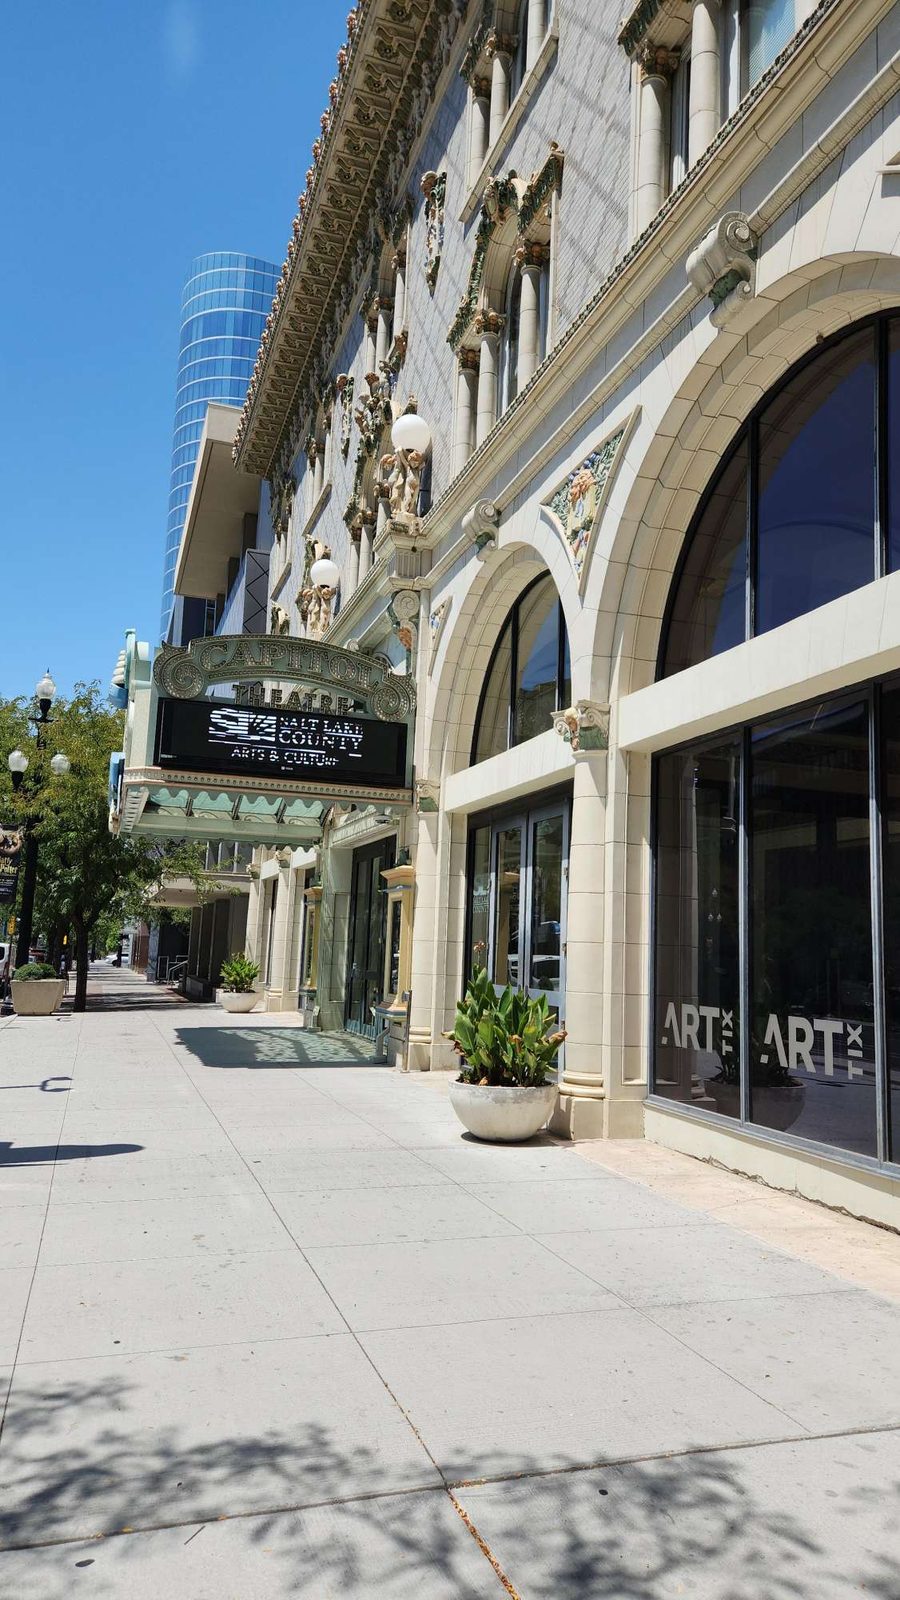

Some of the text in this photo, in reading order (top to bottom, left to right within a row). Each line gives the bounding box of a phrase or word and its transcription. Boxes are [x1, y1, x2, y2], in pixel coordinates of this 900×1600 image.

[200, 640, 379, 690] CAPITOL
[232, 683, 351, 715] THEATRE
[278, 730, 363, 749] COUNTY
[847, 1023, 864, 1080] TIX
